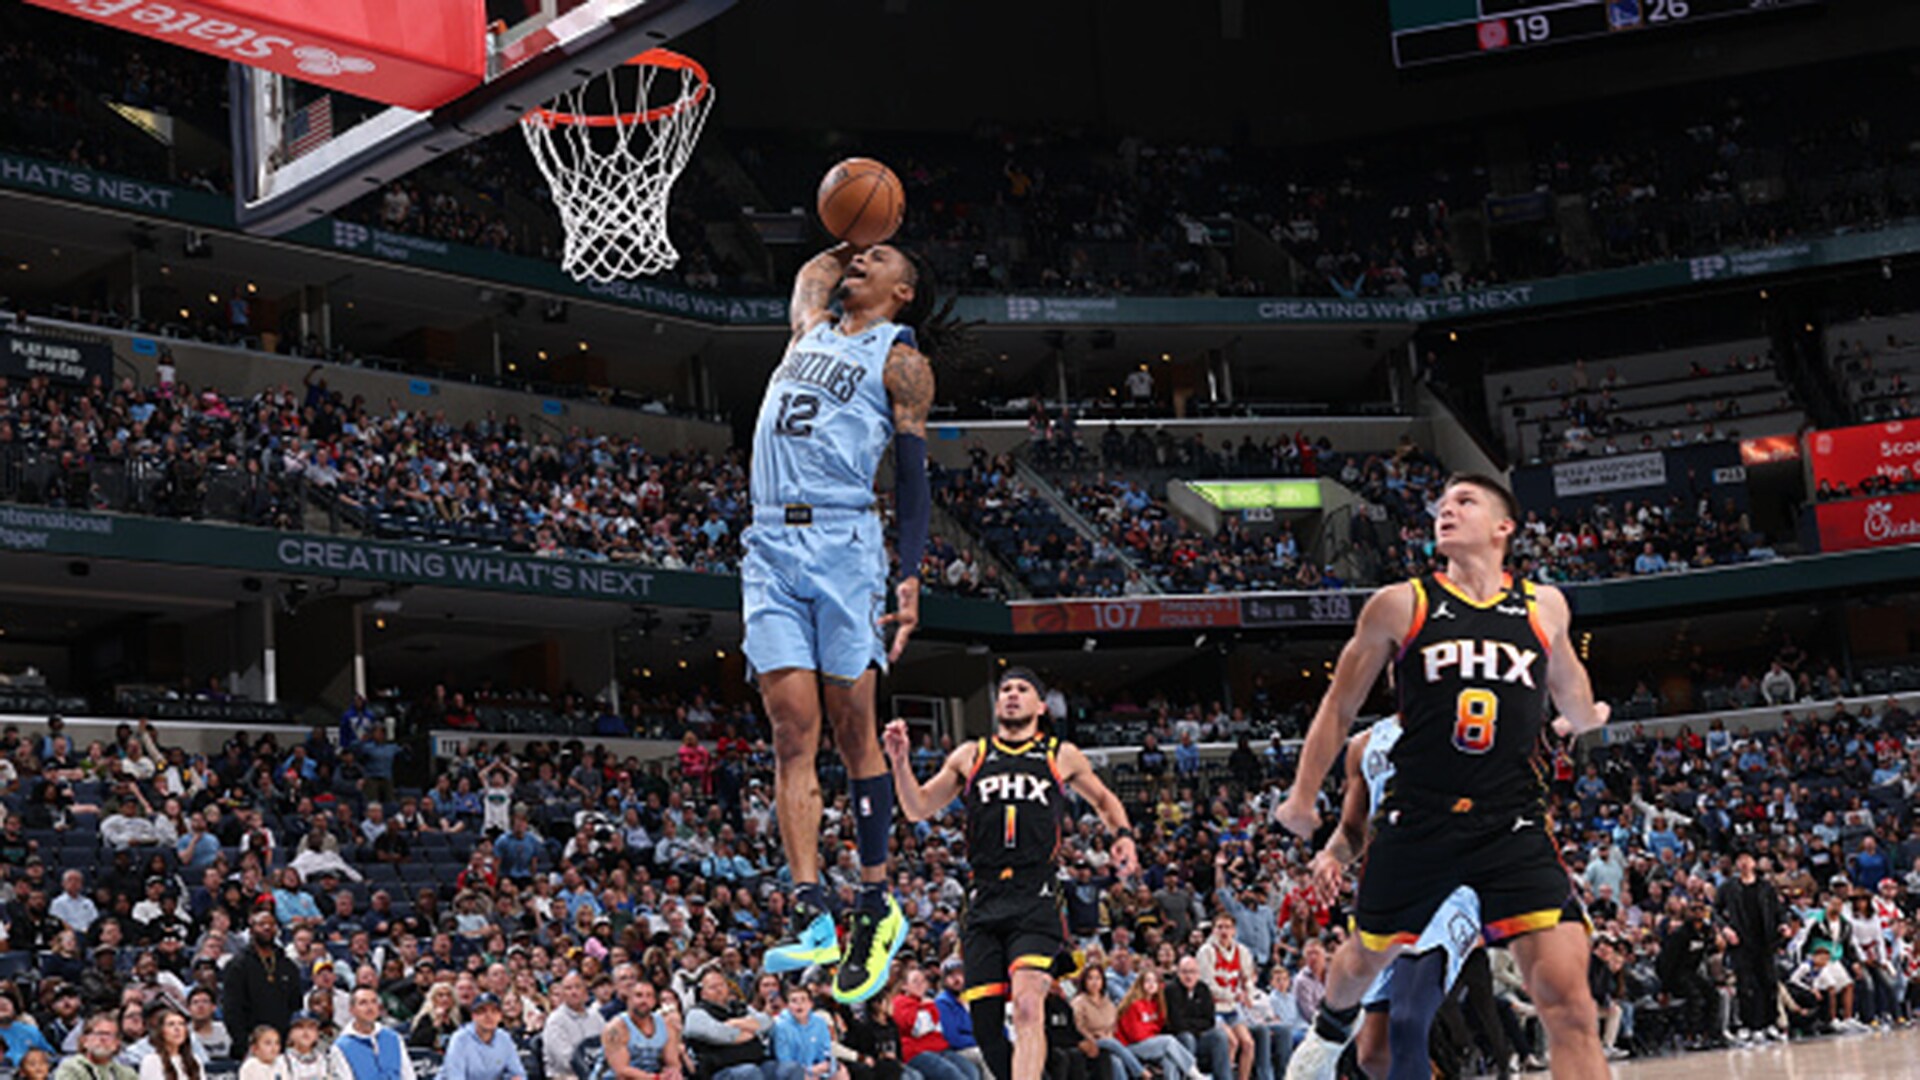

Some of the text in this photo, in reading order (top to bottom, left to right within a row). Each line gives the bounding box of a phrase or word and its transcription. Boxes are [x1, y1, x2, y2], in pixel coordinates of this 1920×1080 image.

[131, 4, 294, 58] State
[1514, 14, 1552, 44] 19
[1648, 0, 1689, 21] 26
[0, 158, 173, 209] HAT'S NEXT
[586, 277, 786, 319] CREATING WHAT'S
[1257, 285, 1533, 323] CREATING WHAT'S NEXT
[774, 392, 821, 437] 12
[0, 507, 113, 534] nternational
[276, 537, 654, 598] CREATING WHAT'S NEXT
[1092, 603, 1143, 630] 107
[1419, 637, 1540, 692] PHX
[1451, 686, 1500, 754] 8
[976, 773, 1052, 806] PHX
[1004, 804, 1018, 849] 1
